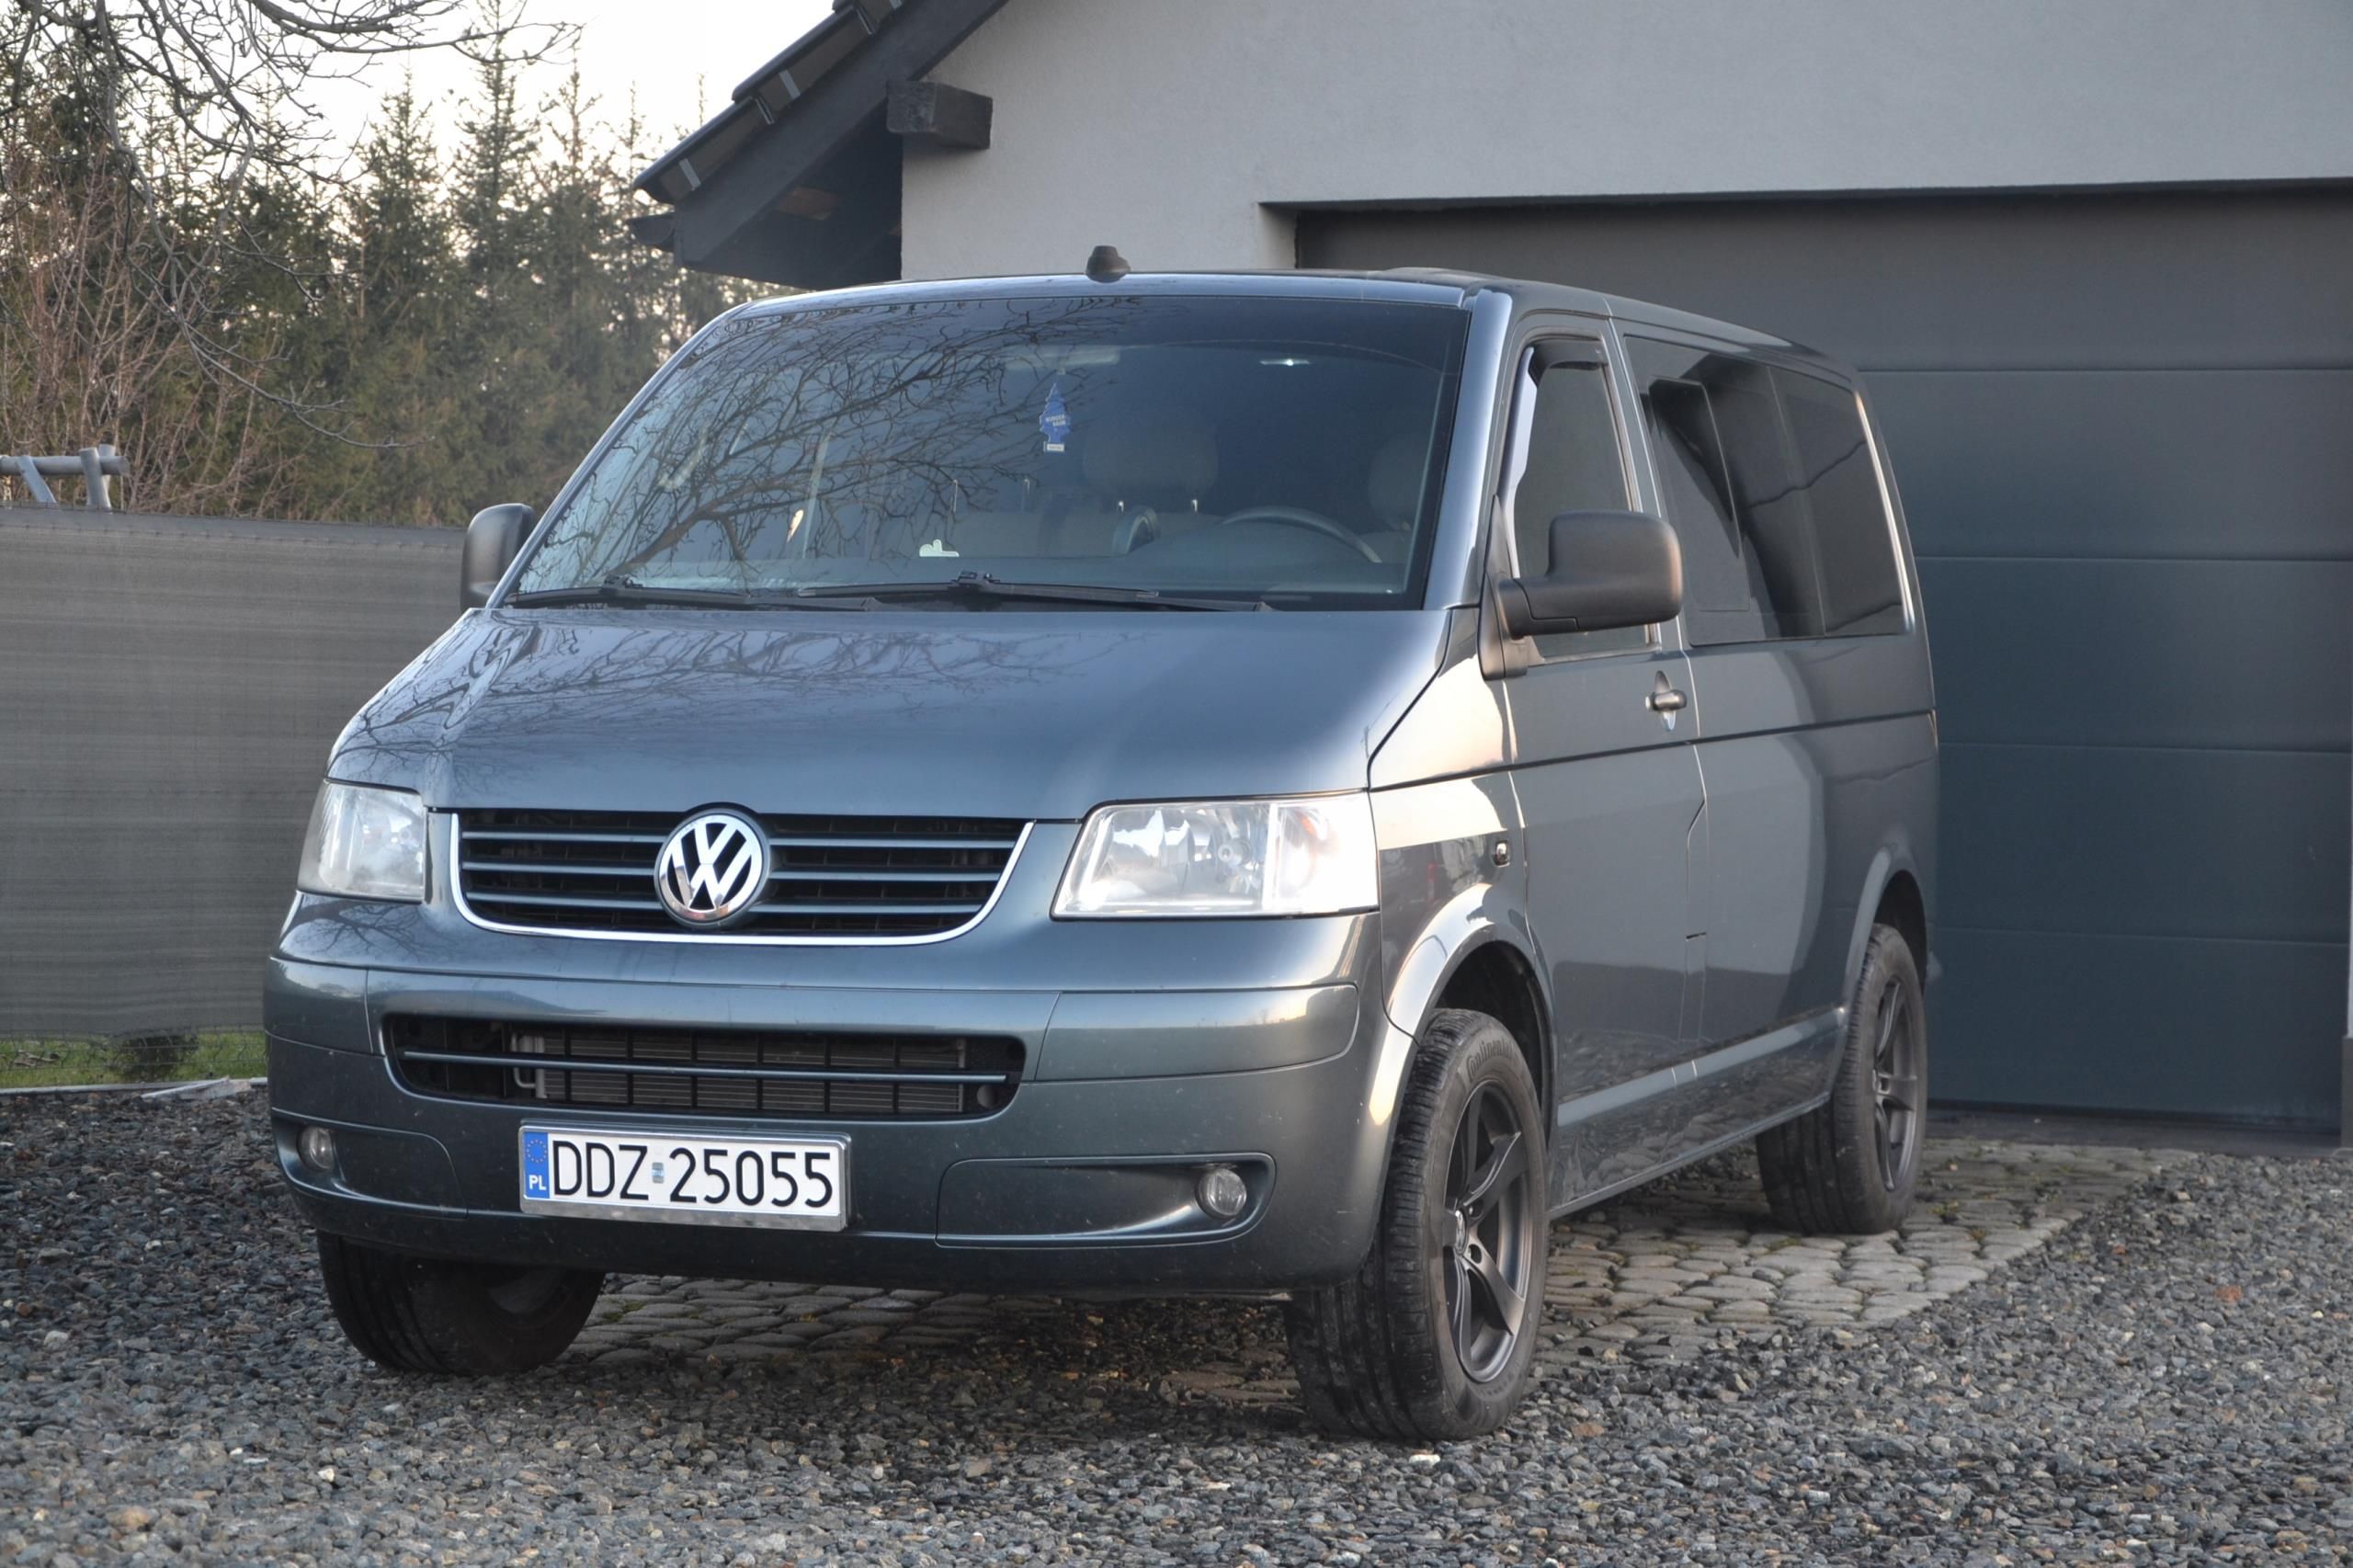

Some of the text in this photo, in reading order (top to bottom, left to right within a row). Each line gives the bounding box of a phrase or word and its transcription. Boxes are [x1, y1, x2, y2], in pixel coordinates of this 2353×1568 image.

[660, 815, 761, 919] VW
[529, 1174, 547, 1190] PL
[553, 1140, 833, 1208] DDZ 25055
